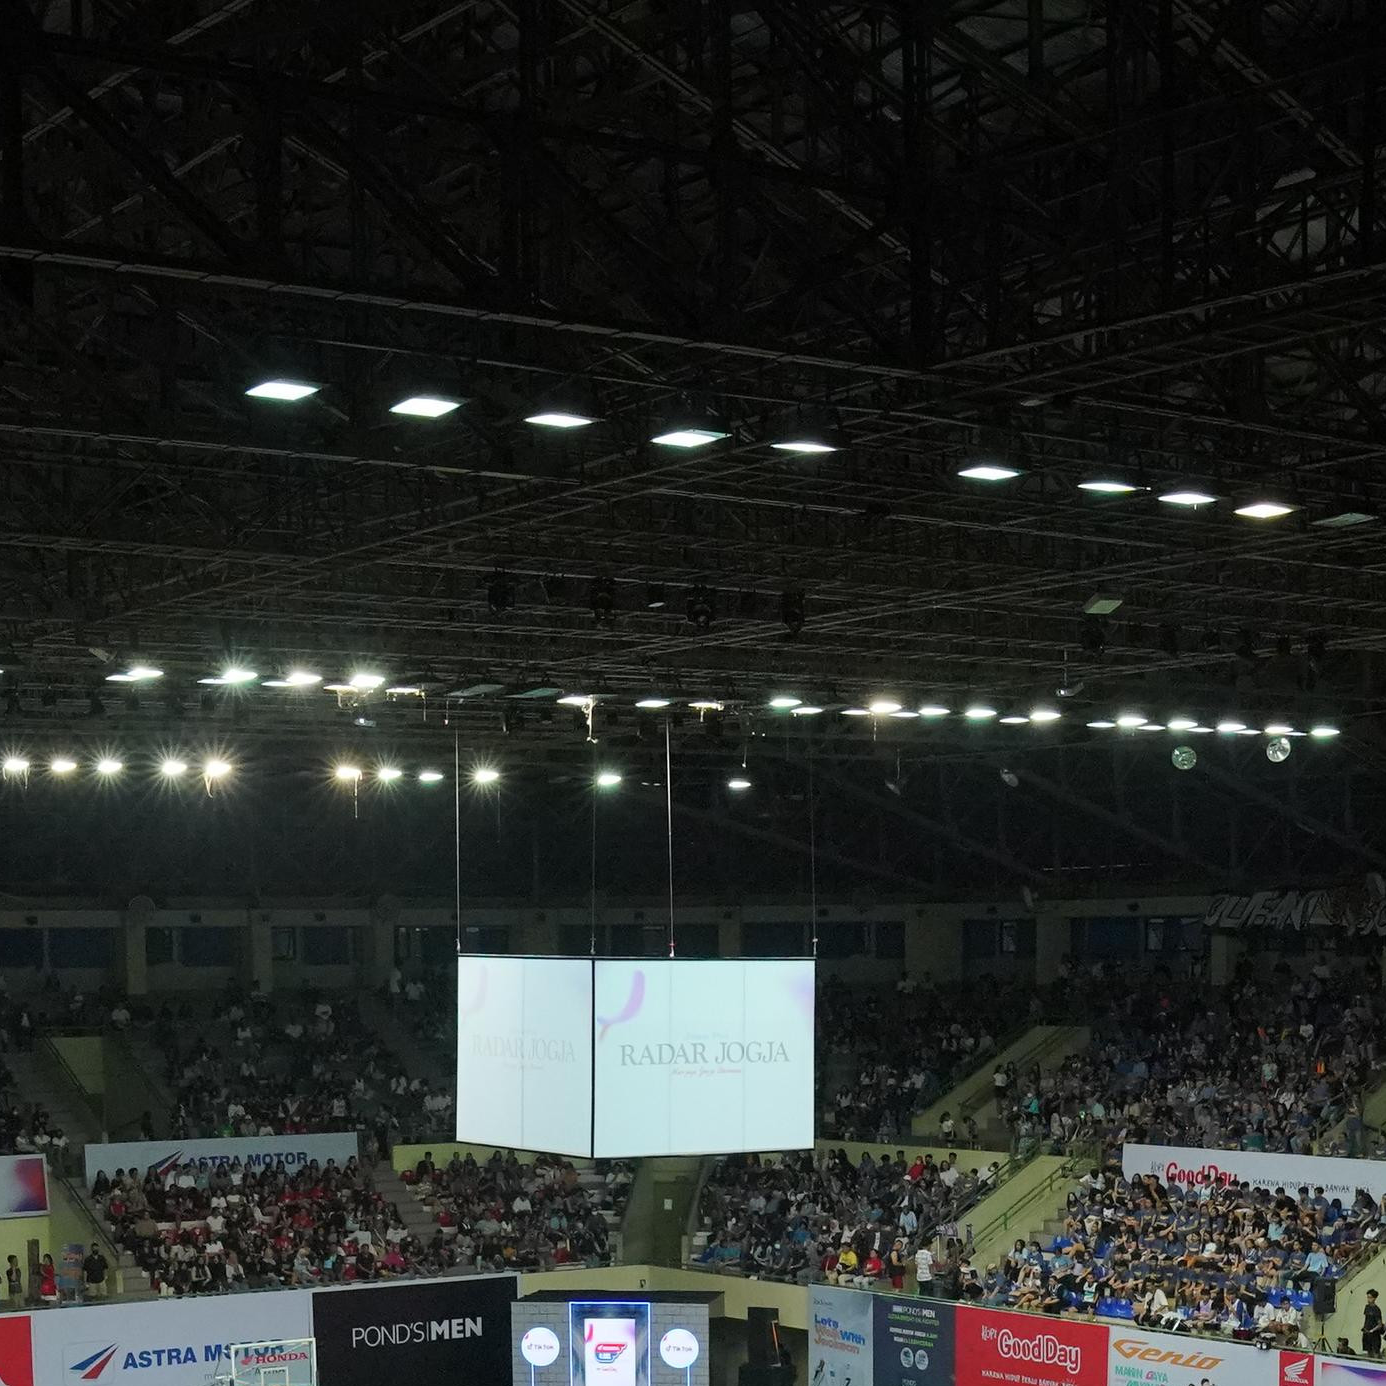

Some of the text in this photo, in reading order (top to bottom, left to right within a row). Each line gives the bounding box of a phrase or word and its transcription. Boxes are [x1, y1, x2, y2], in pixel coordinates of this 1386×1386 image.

[619, 1040, 791, 1067] RADAR JOGJA
[247, 1152, 308, 1167] MOTOR
[430, 1316, 483, 1341] MEN
[122, 1346, 197, 1370] ASTRA
[254, 1351, 309, 1364] HONDA
[997, 1328, 1045, 1365] Good
[1044, 1334, 1082, 1374] Day
[1112, 1338, 1225, 1370] Genio
[981, 1369, 1004, 1380] KARENA
[1004, 1373, 1021, 1382] HIDUP
